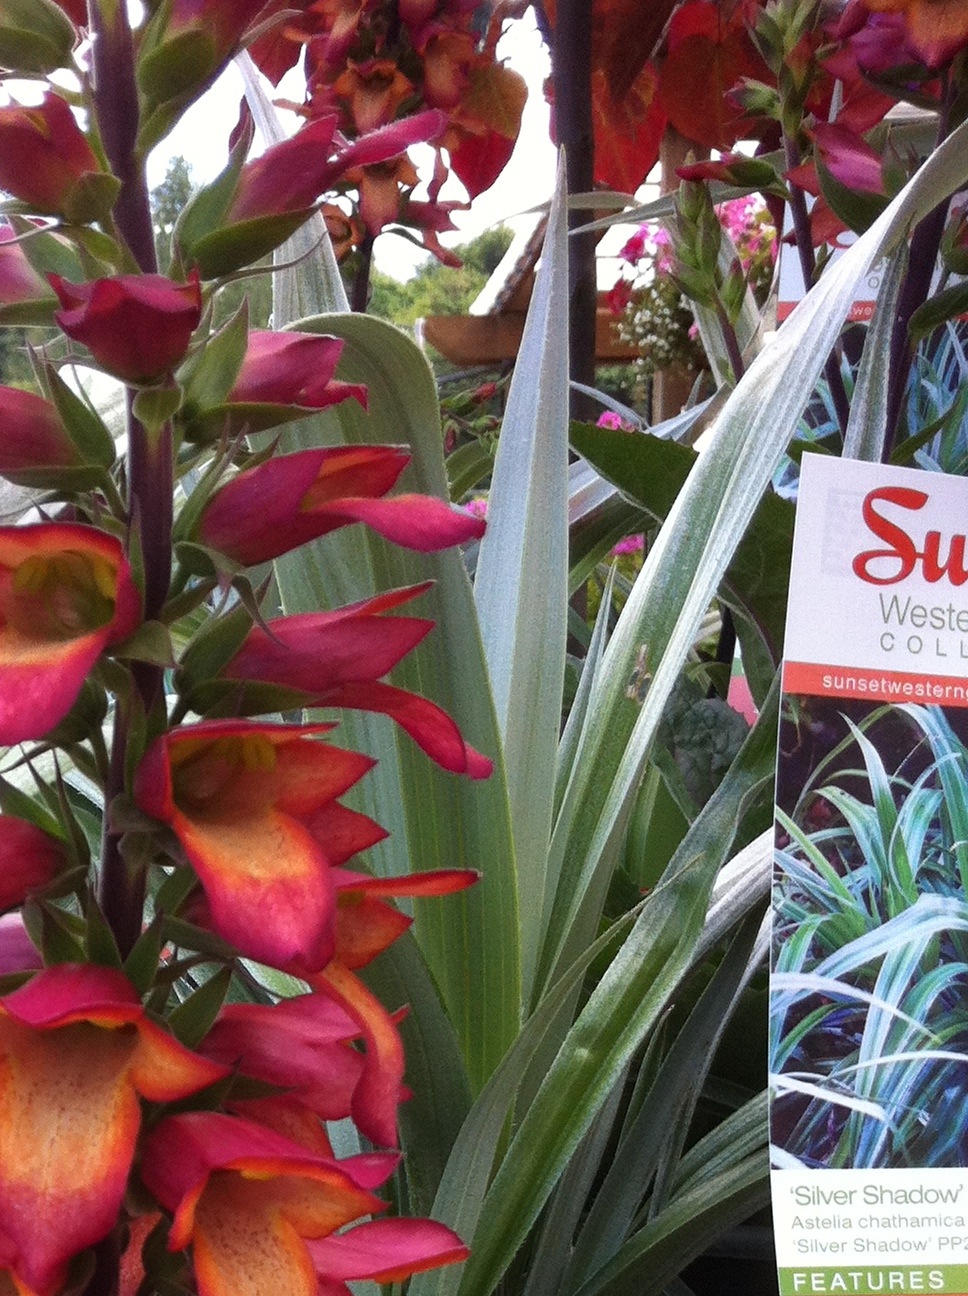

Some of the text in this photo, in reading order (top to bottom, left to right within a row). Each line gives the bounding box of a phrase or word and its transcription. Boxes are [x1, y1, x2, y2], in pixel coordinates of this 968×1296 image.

[791, 1213, 965, 1230] Astelia chathamica
[793, 1270, 945, 1292] FEATURES
